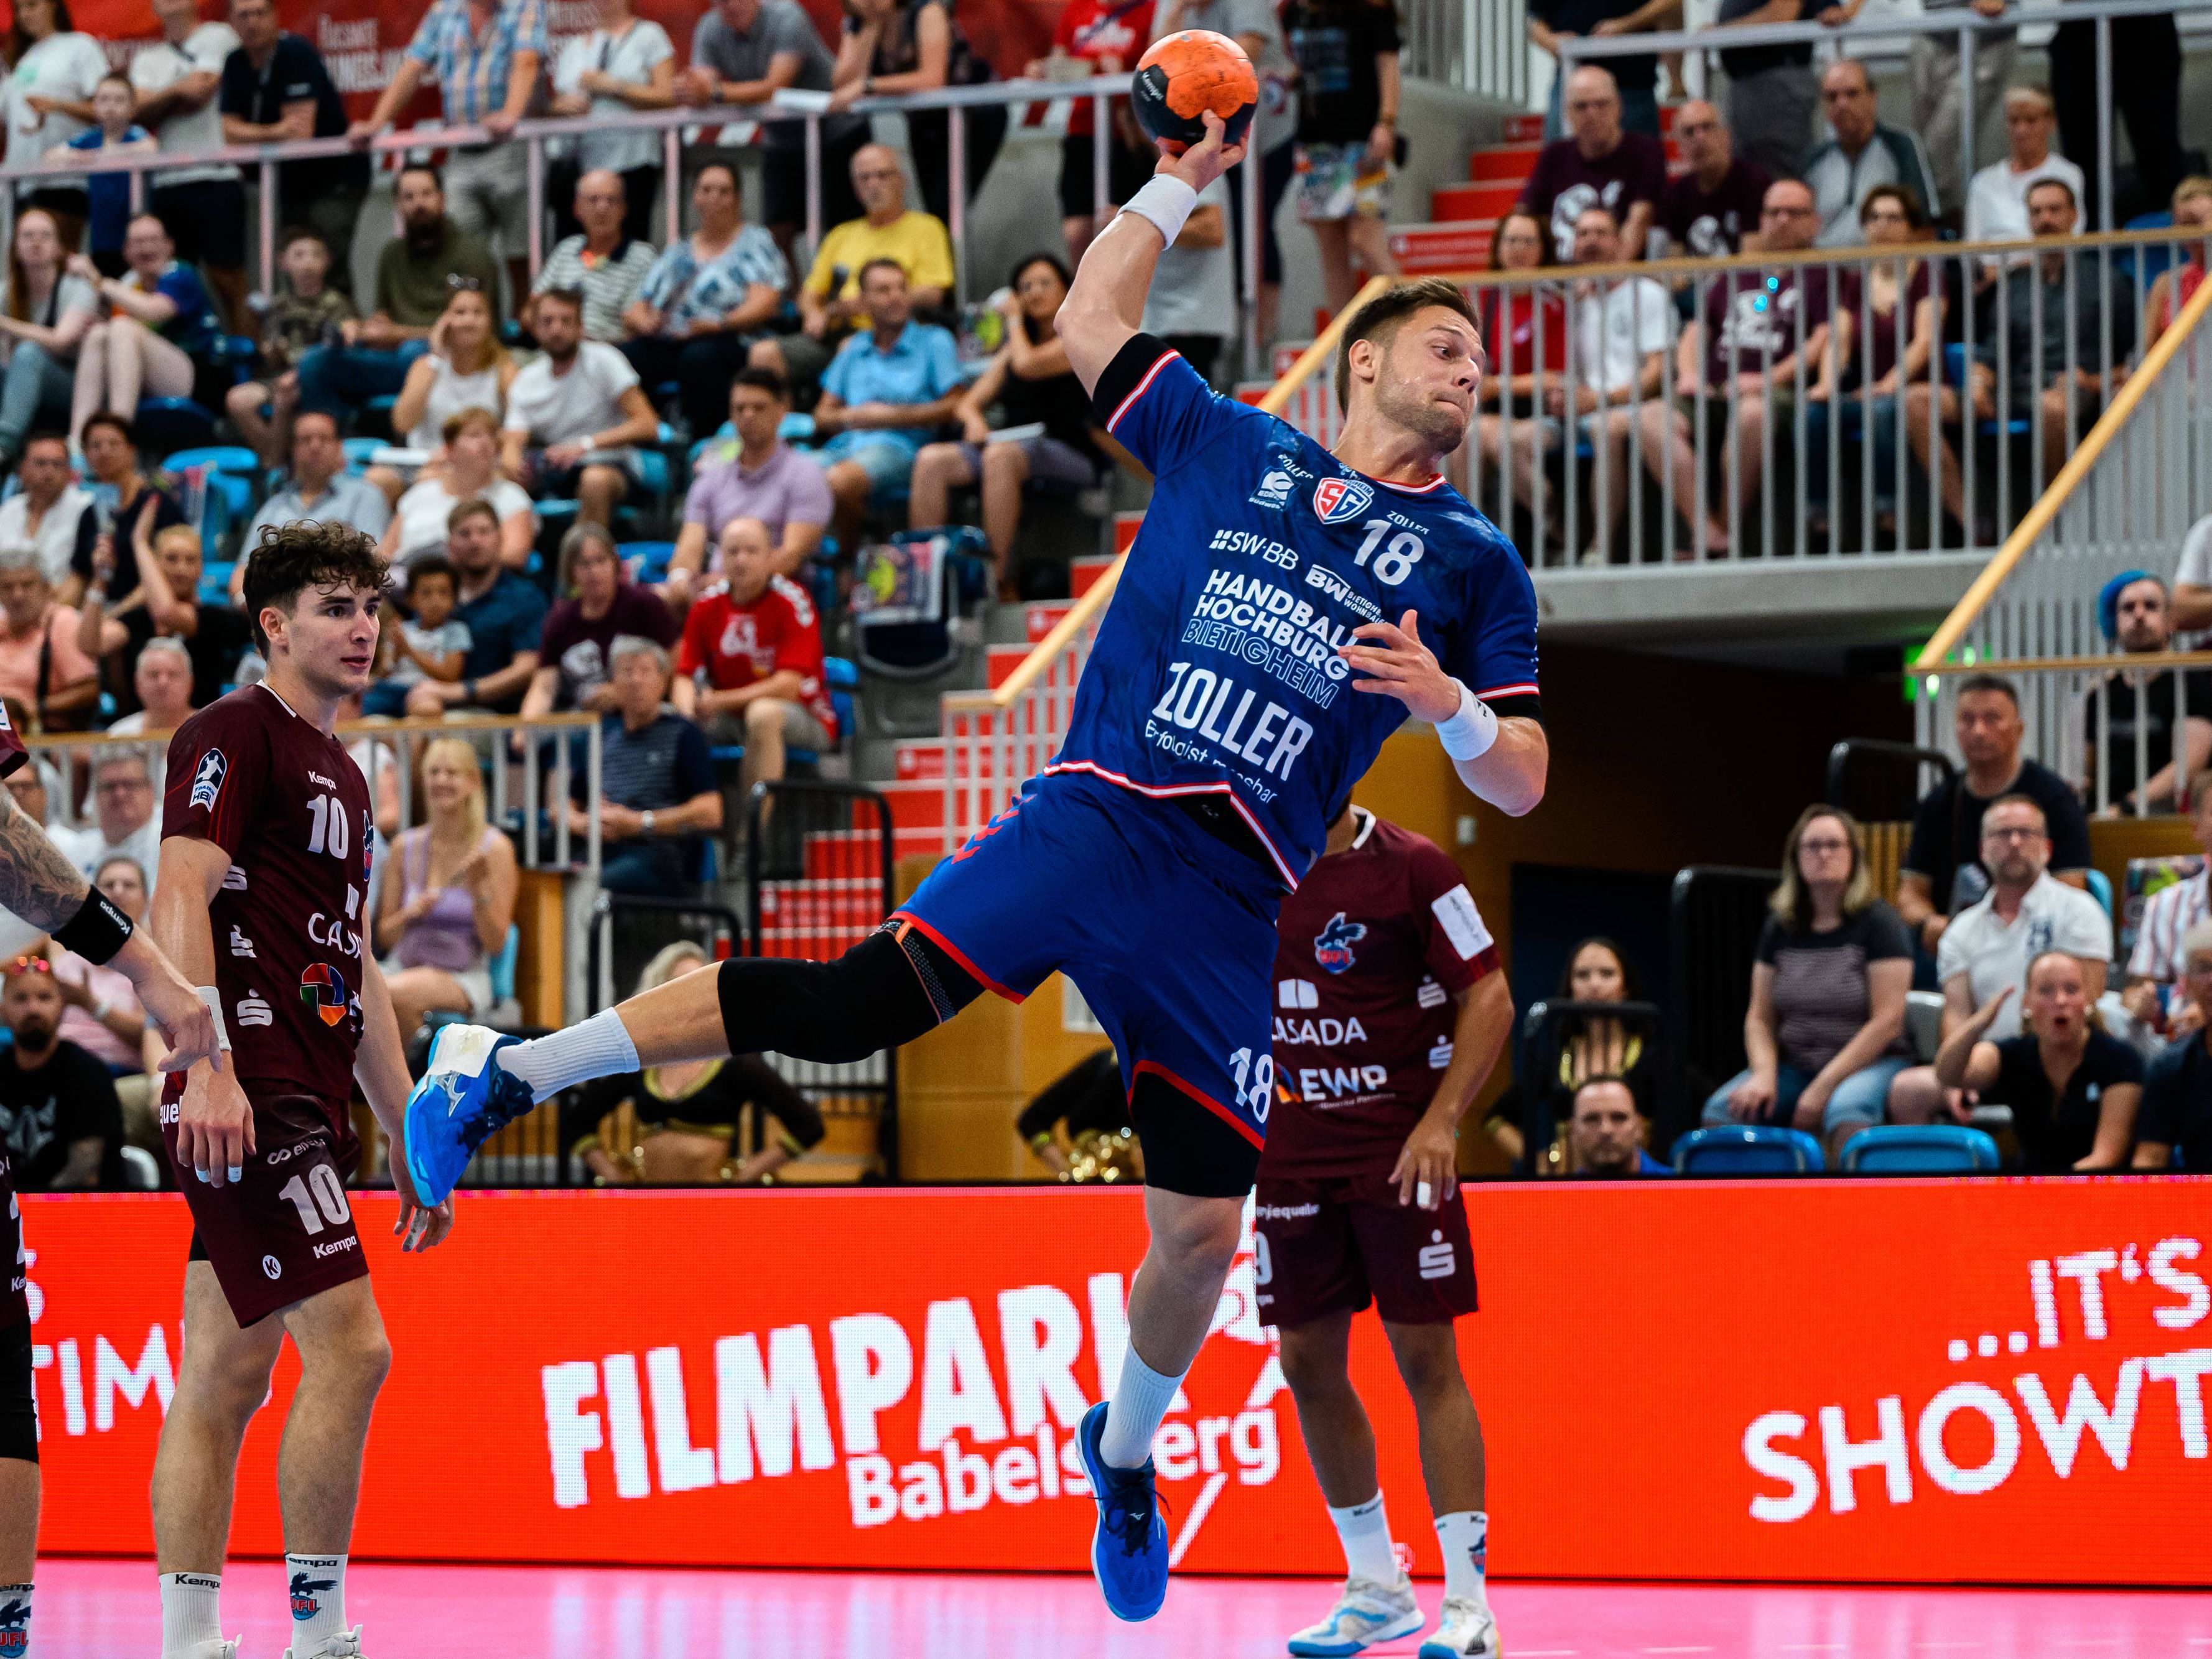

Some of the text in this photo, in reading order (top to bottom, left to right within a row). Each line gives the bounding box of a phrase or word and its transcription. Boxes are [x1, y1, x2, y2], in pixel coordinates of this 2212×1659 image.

[1354, 519, 1425, 586] 18
[1305, 570, 1347, 602] BW
[1193, 595, 1349, 681] HOCHBURG
[1183, 619, 1340, 710] BIETIGHEIM
[1151, 662, 1314, 782] ZOLLER
[192, 791, 211, 807] HBL
[307, 793, 349, 860] 10
[100, 901, 131, 934] Kempa
[1273, 1016, 1367, 1046] ASADA
[1229, 1047, 1273, 1123] 18
[1299, 1064, 1388, 1102] EWP
[279, 1164, 350, 1236] 10
[313, 1235, 358, 1259] Kempa
[845, 1408, 1281, 1528] Babelserg
[175, 1573, 220, 1589] Kemp
[285, 1551, 338, 1568] empa
